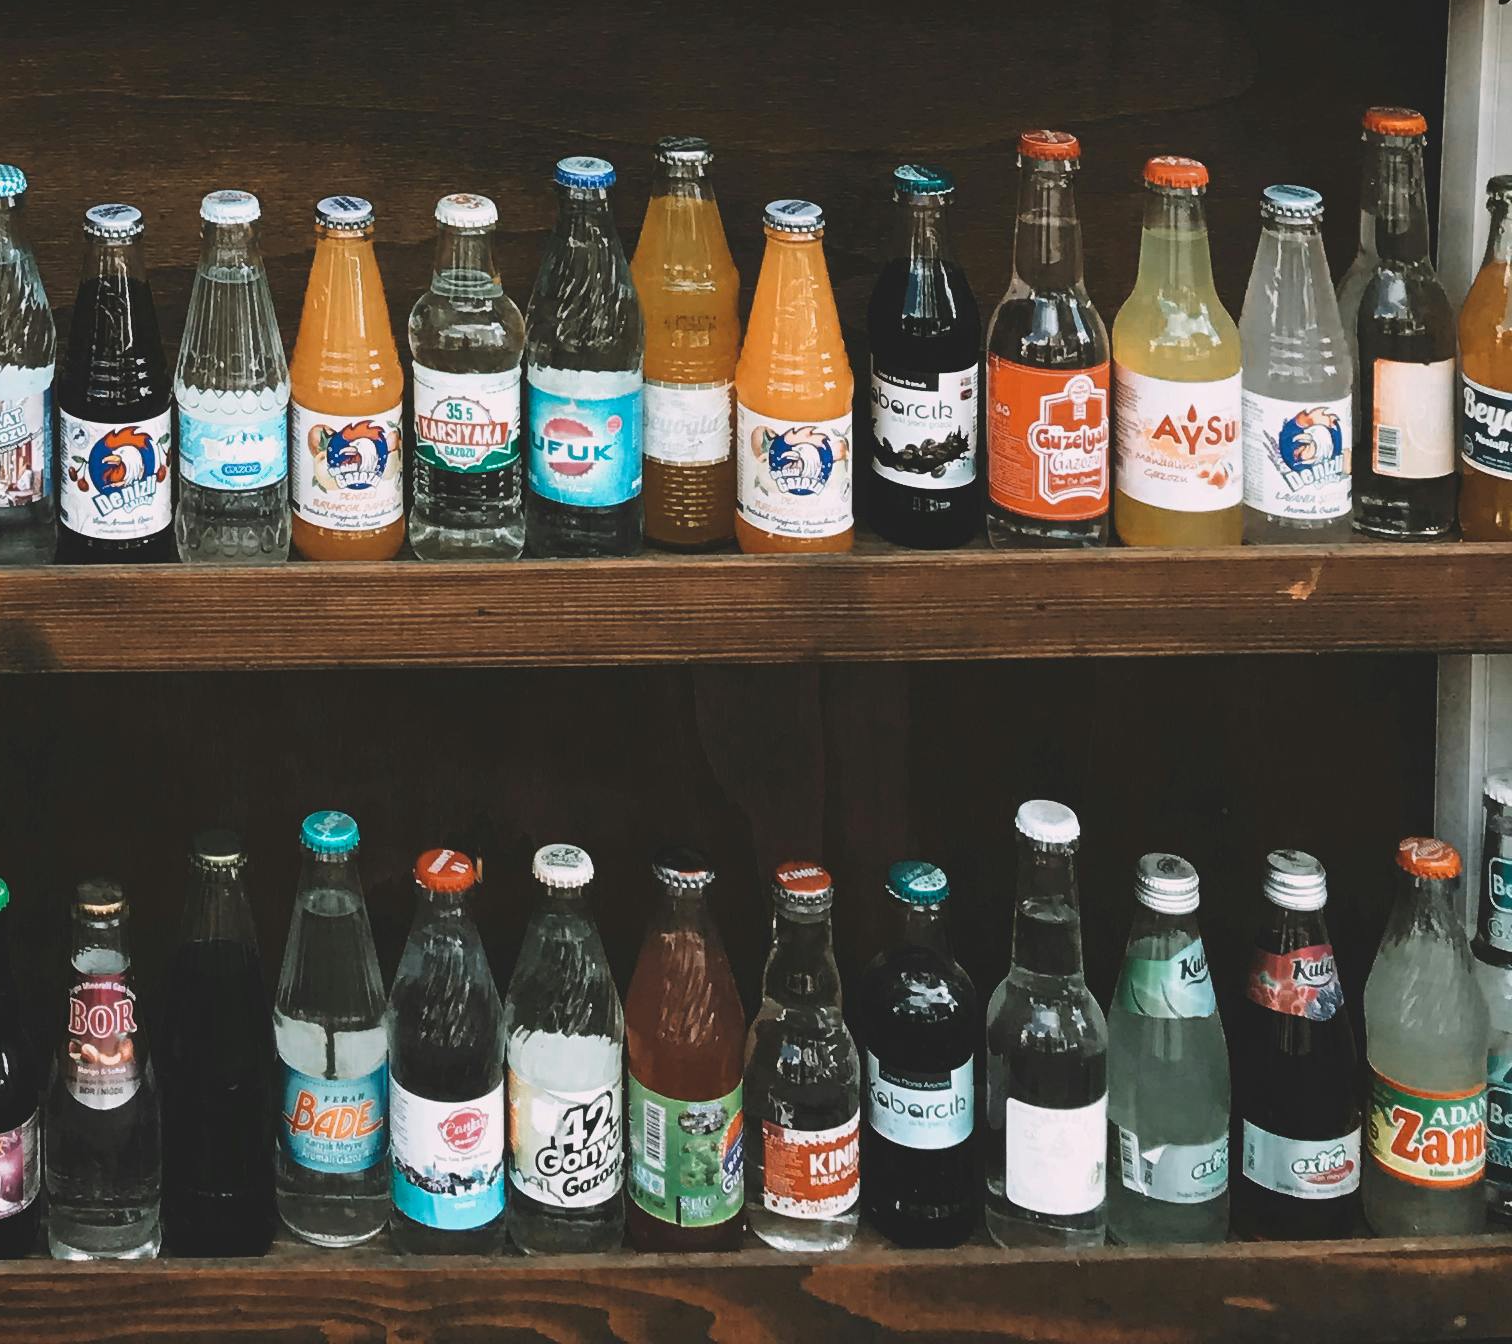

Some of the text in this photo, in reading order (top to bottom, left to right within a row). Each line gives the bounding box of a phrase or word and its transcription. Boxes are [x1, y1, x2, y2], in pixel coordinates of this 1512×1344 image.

[444, 445, 478, 459] GAZOZU
[531, 437, 613, 463] UFUK
[69, 999, 138, 1038] BOR
[283, 1090, 384, 1140] BADE
[564, 1091, 614, 1156] 42
[535, 1126, 622, 1178] Gonya
[810, 1171, 840, 1187] BURSA
